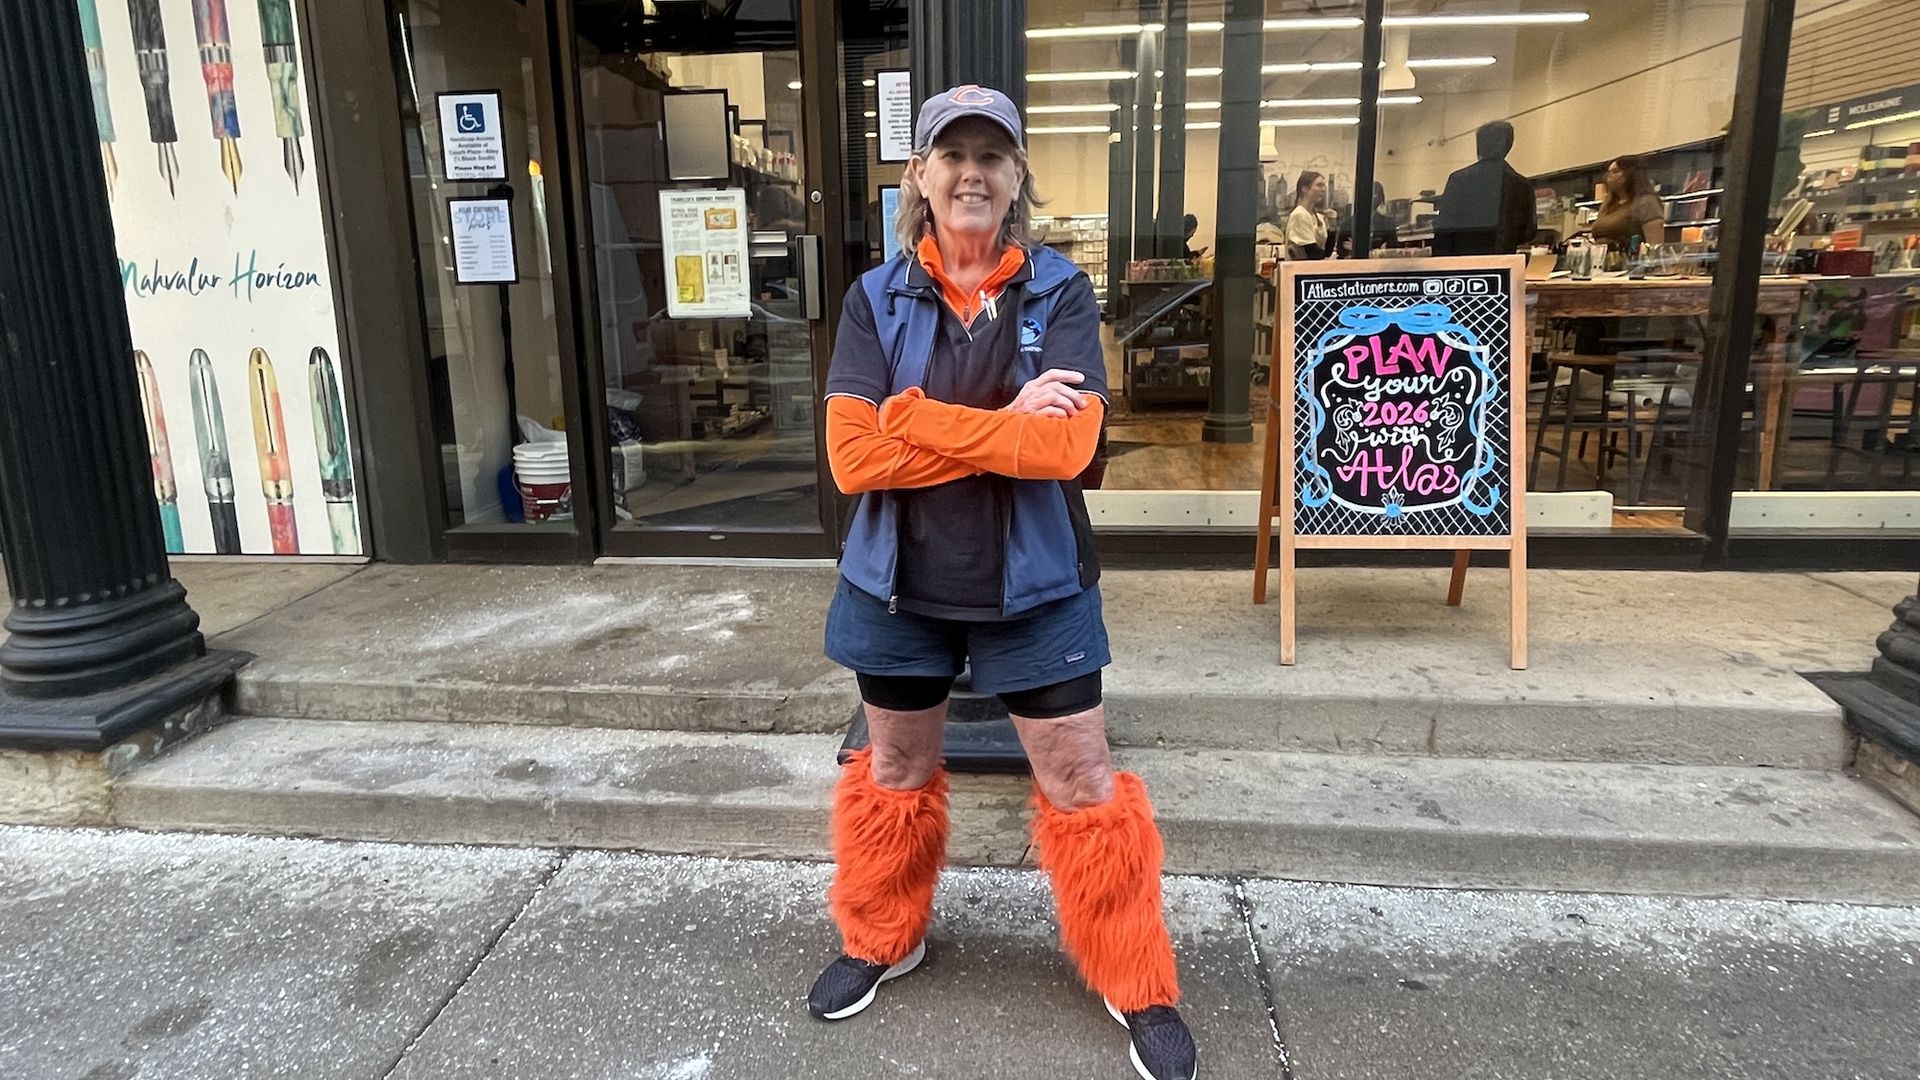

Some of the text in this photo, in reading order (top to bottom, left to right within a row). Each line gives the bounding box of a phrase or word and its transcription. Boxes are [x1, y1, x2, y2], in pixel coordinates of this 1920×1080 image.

[1848, 96, 1903, 115] MOLESKINE
[454, 209, 507, 224] STORE
[119, 249, 321, 302] Nahvalur Horizon
[1306, 281, 1420, 299] Atlasstationers.com
[1343, 334, 1452, 379] PLAN
[1363, 400, 1430, 426] 2026
[1366, 425, 1429, 447] with
[1337, 445, 1461, 497] Atlas
